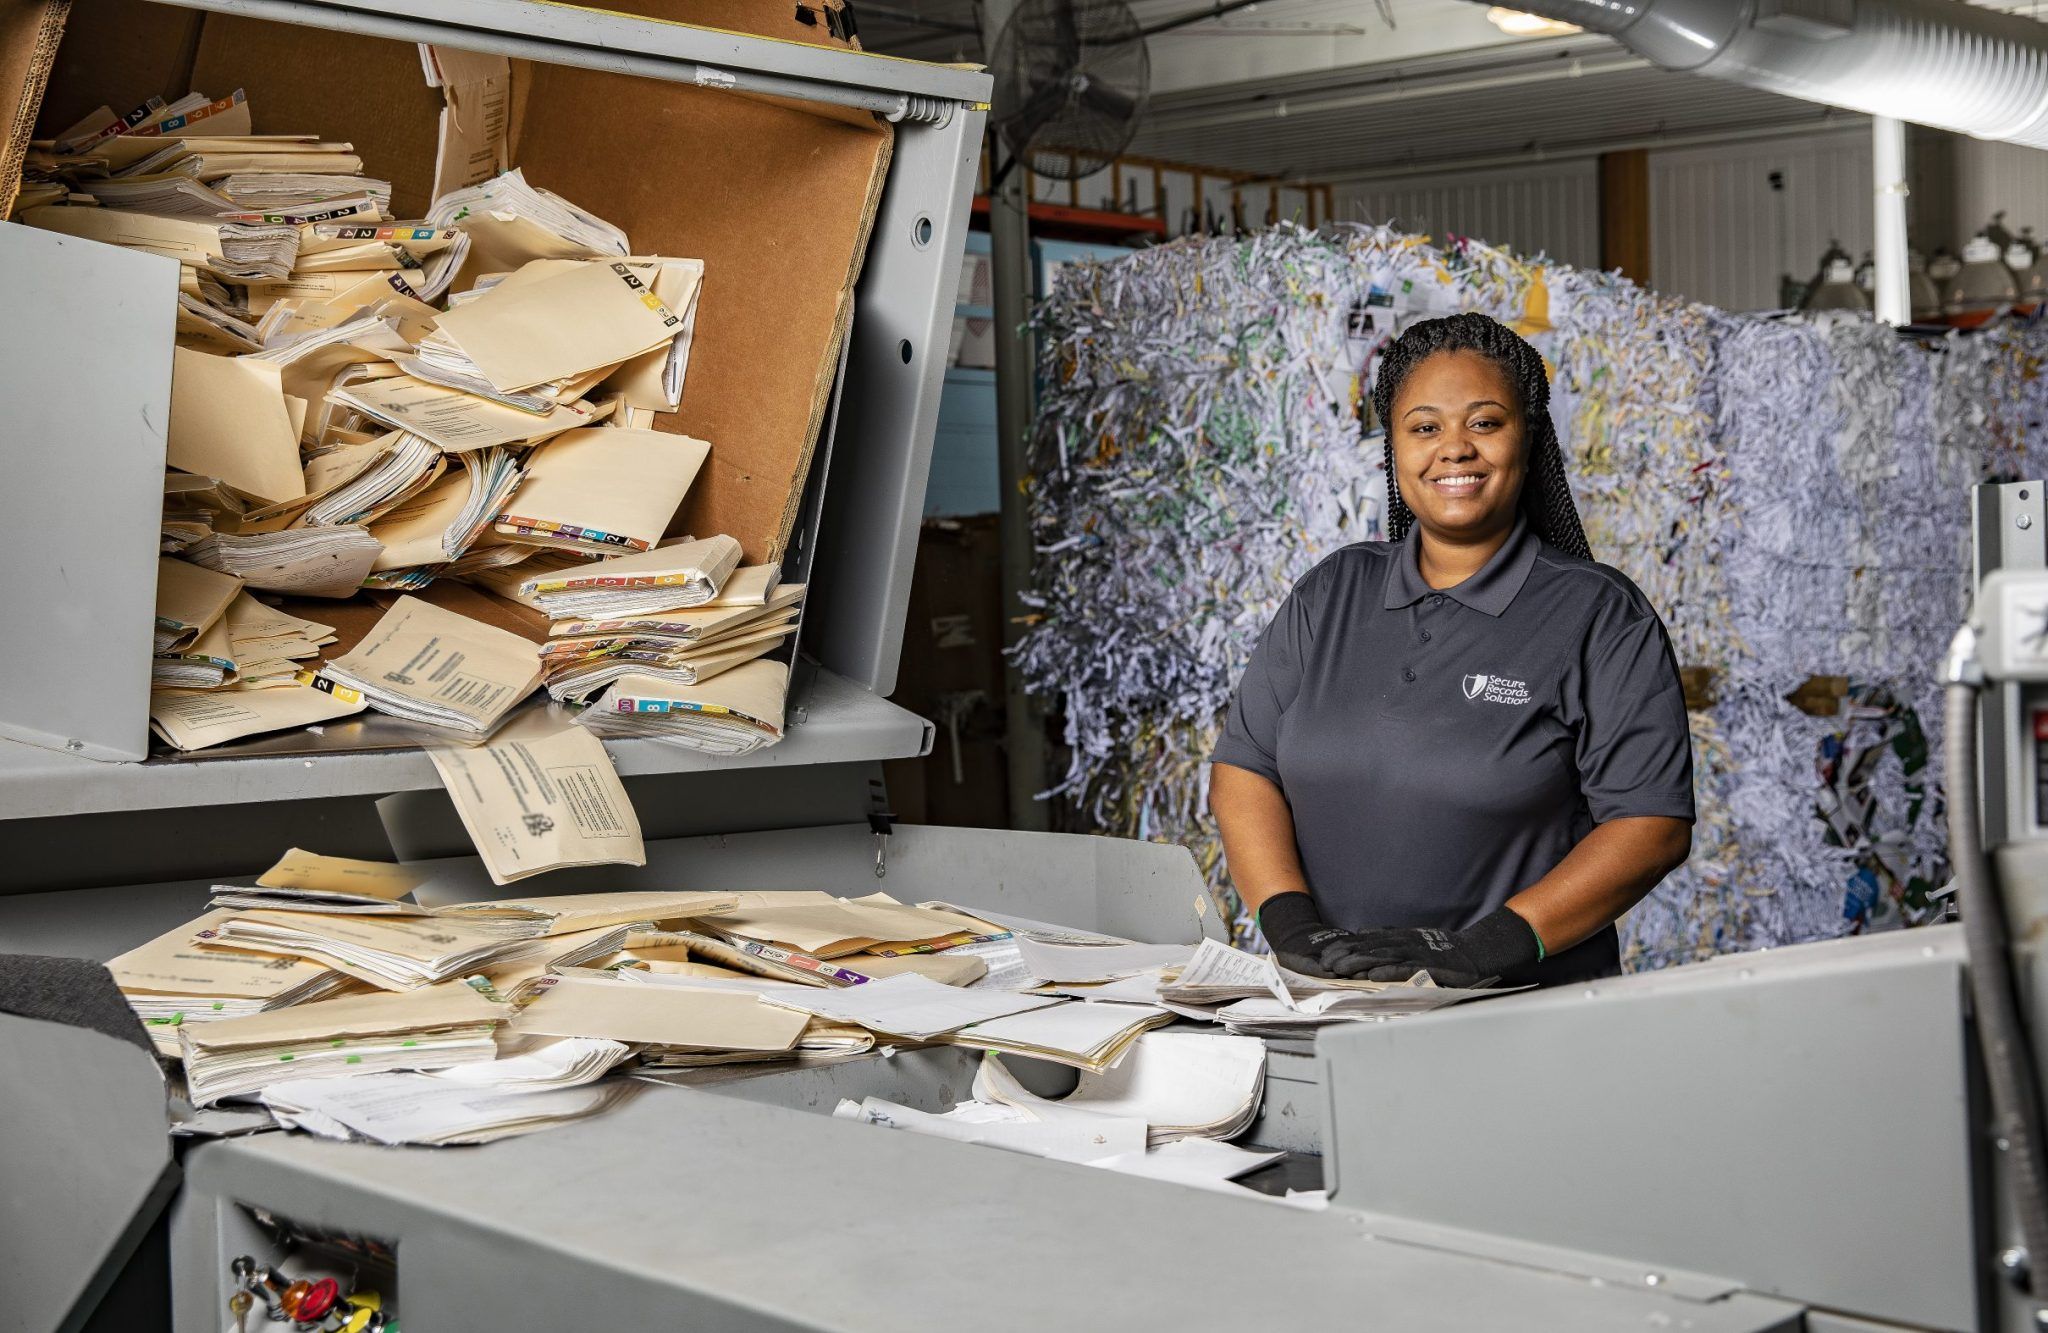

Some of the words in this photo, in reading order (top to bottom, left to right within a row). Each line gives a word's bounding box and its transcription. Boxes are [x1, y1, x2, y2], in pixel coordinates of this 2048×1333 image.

[131, 109, 144, 122] 2
[360, 230, 372, 238] 2
[394, 279, 404, 287] 4
[627, 276, 640, 286] 2
[1488, 674, 1526, 689] Secure
[317, 680, 328, 689] 2
[340, 687, 353, 697] 3
[1486, 684, 1528, 697] Records
[845, 973, 860, 982] 4
